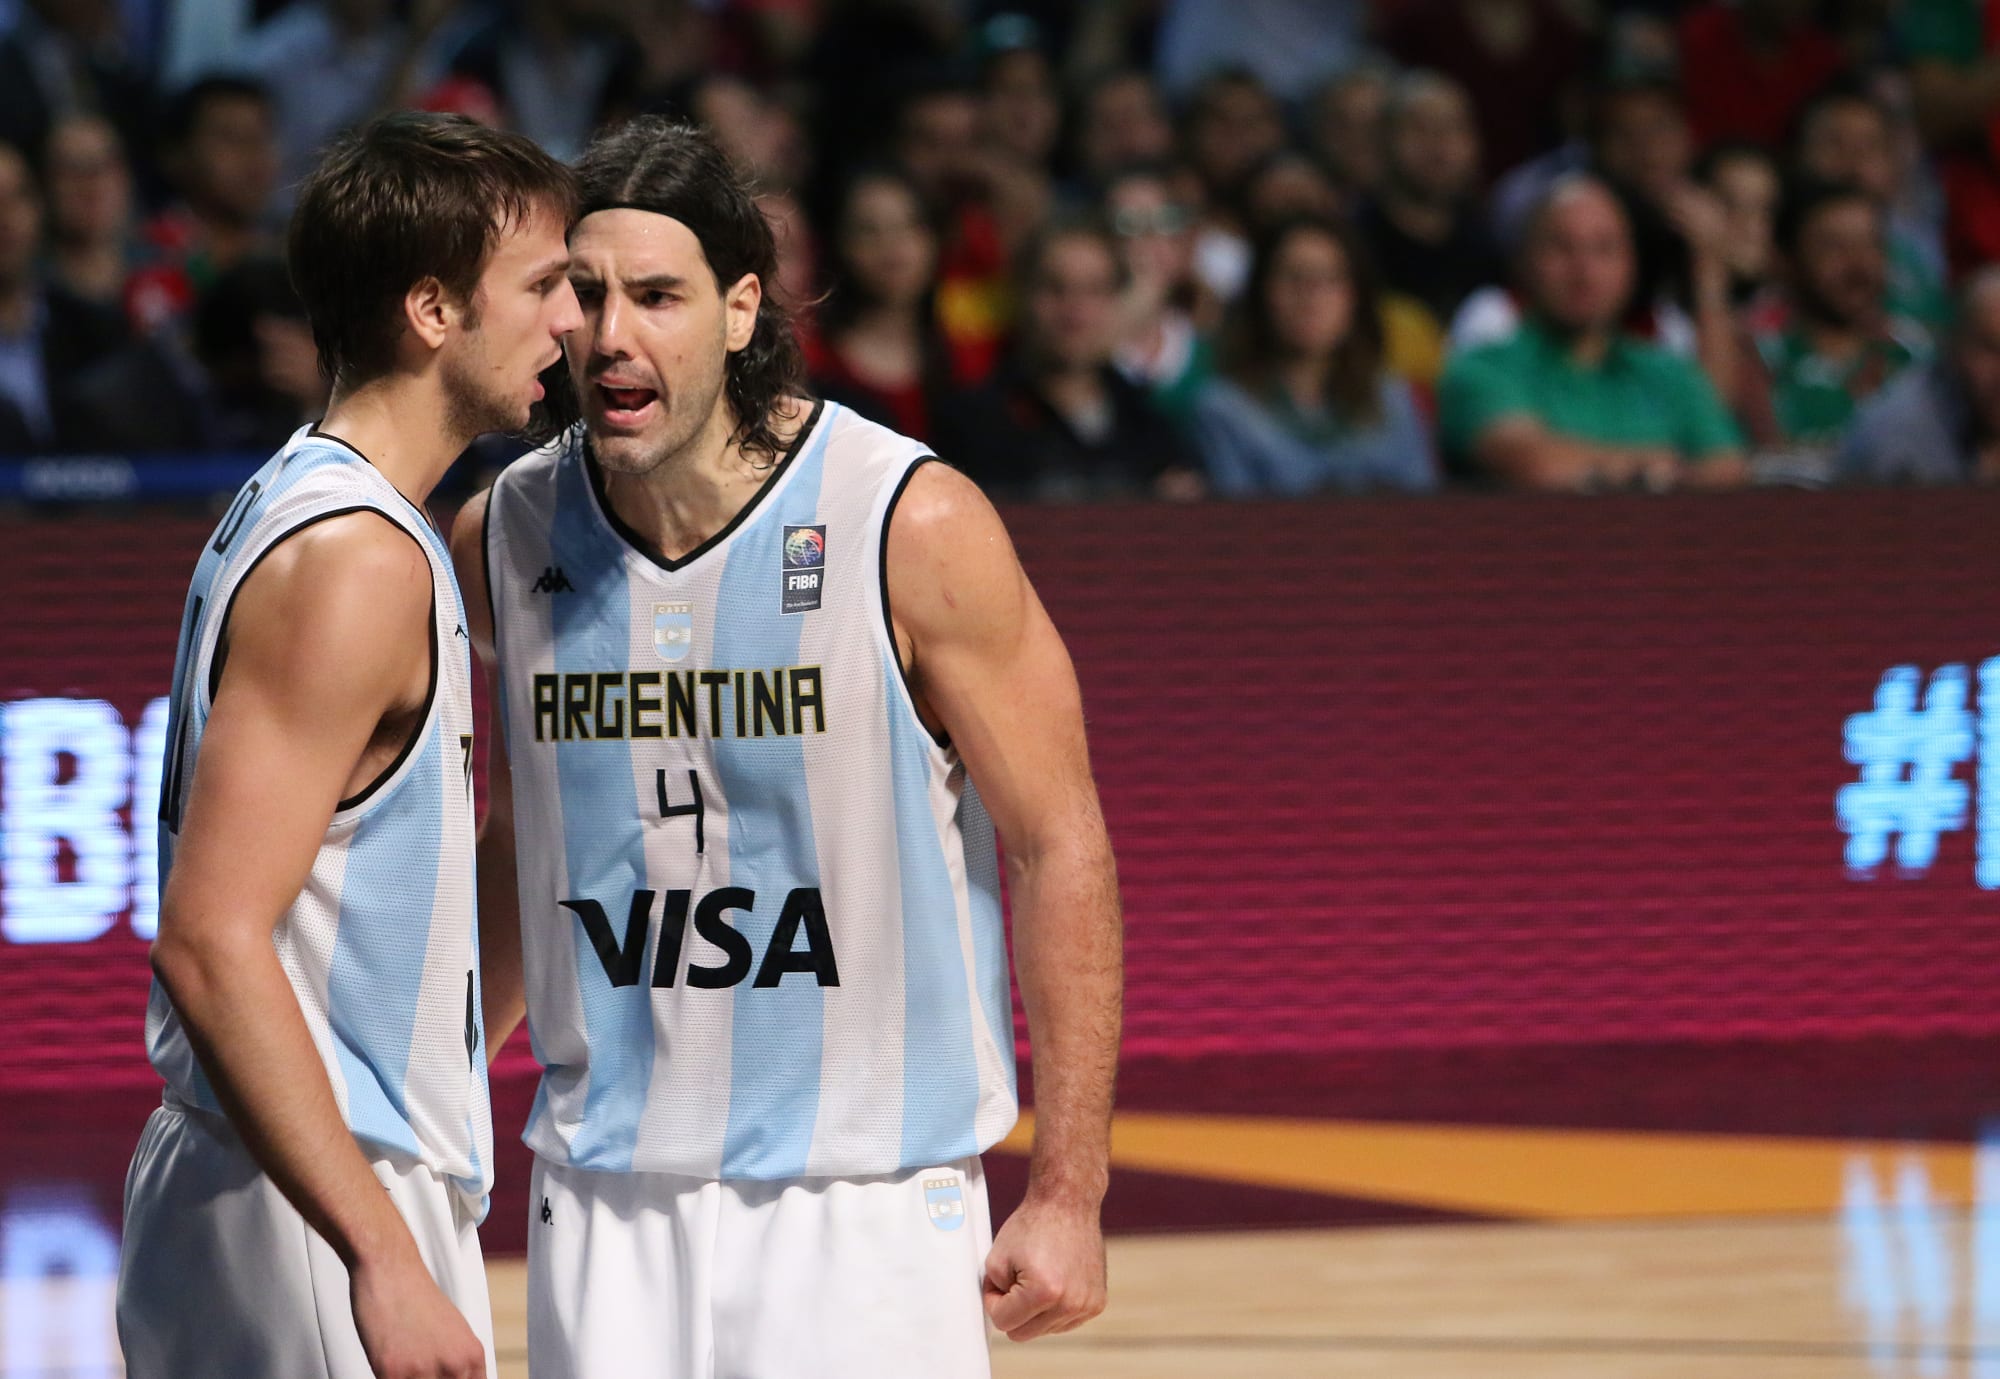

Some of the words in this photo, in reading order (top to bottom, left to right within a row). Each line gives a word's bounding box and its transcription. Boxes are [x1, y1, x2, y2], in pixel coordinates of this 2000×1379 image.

[788, 573, 819, 591] FIBA
[533, 664, 827, 743] ARGENTINA
[656, 768, 704, 854] 4
[557, 886, 841, 990] VISA
